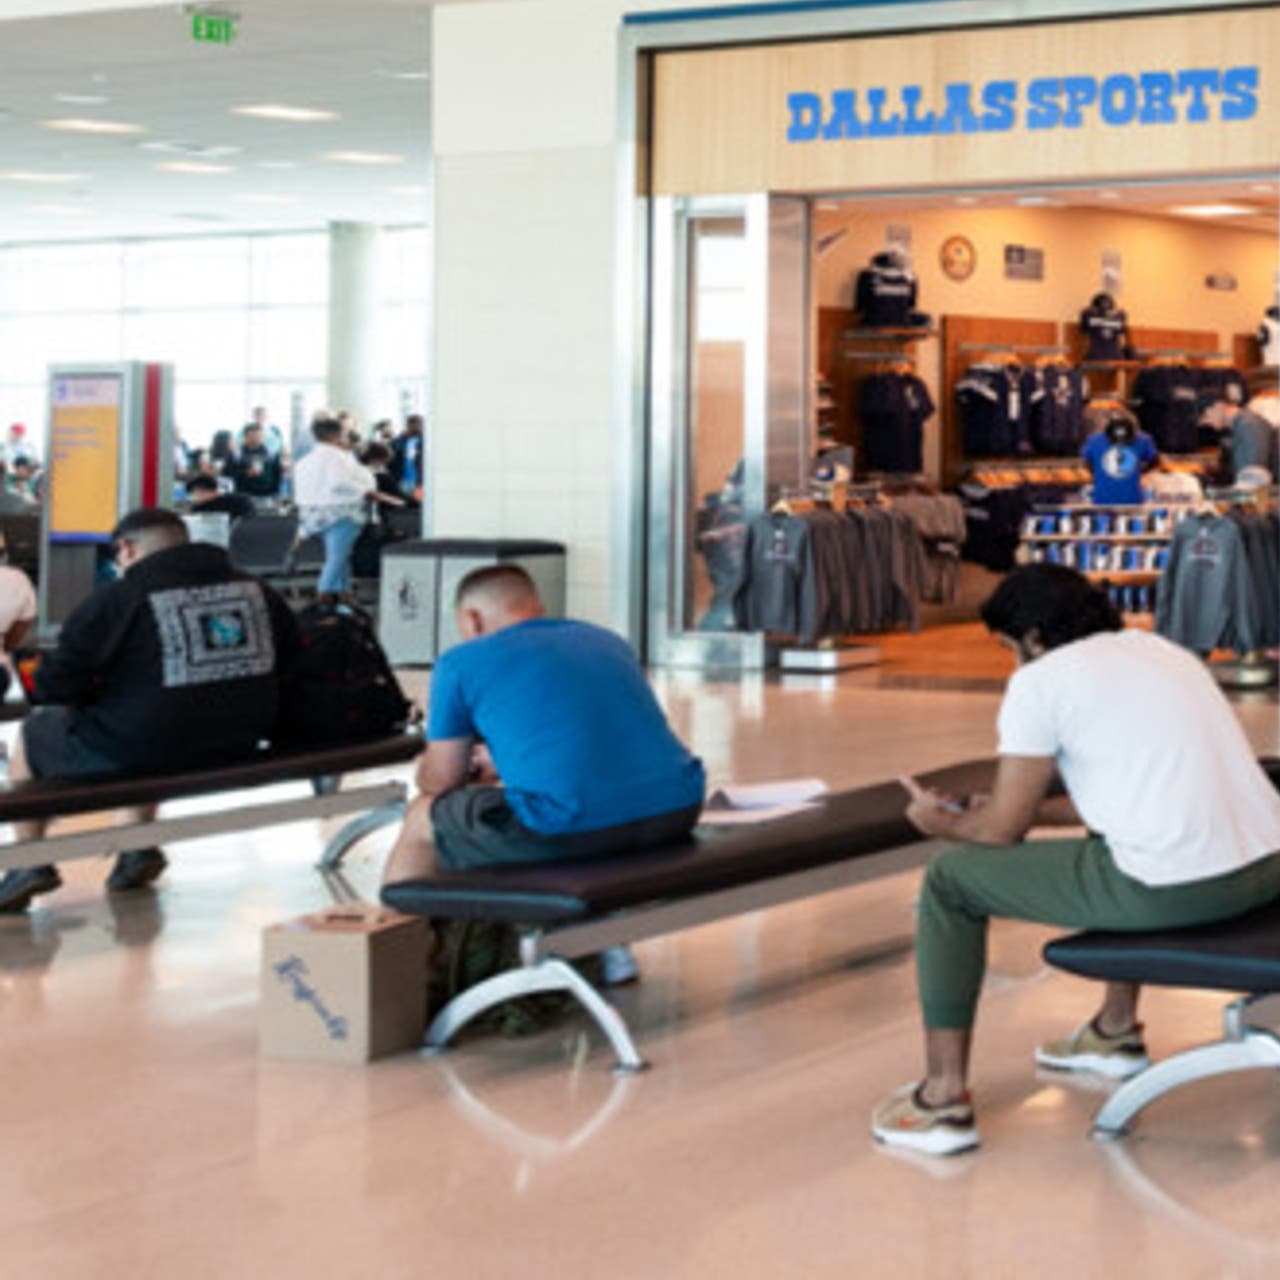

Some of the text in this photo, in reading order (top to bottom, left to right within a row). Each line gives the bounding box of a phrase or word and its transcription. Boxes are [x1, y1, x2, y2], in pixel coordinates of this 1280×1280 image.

[192, 13, 233, 45] EXIT
[787, 66, 1260, 142] DALLAS SPORTS
